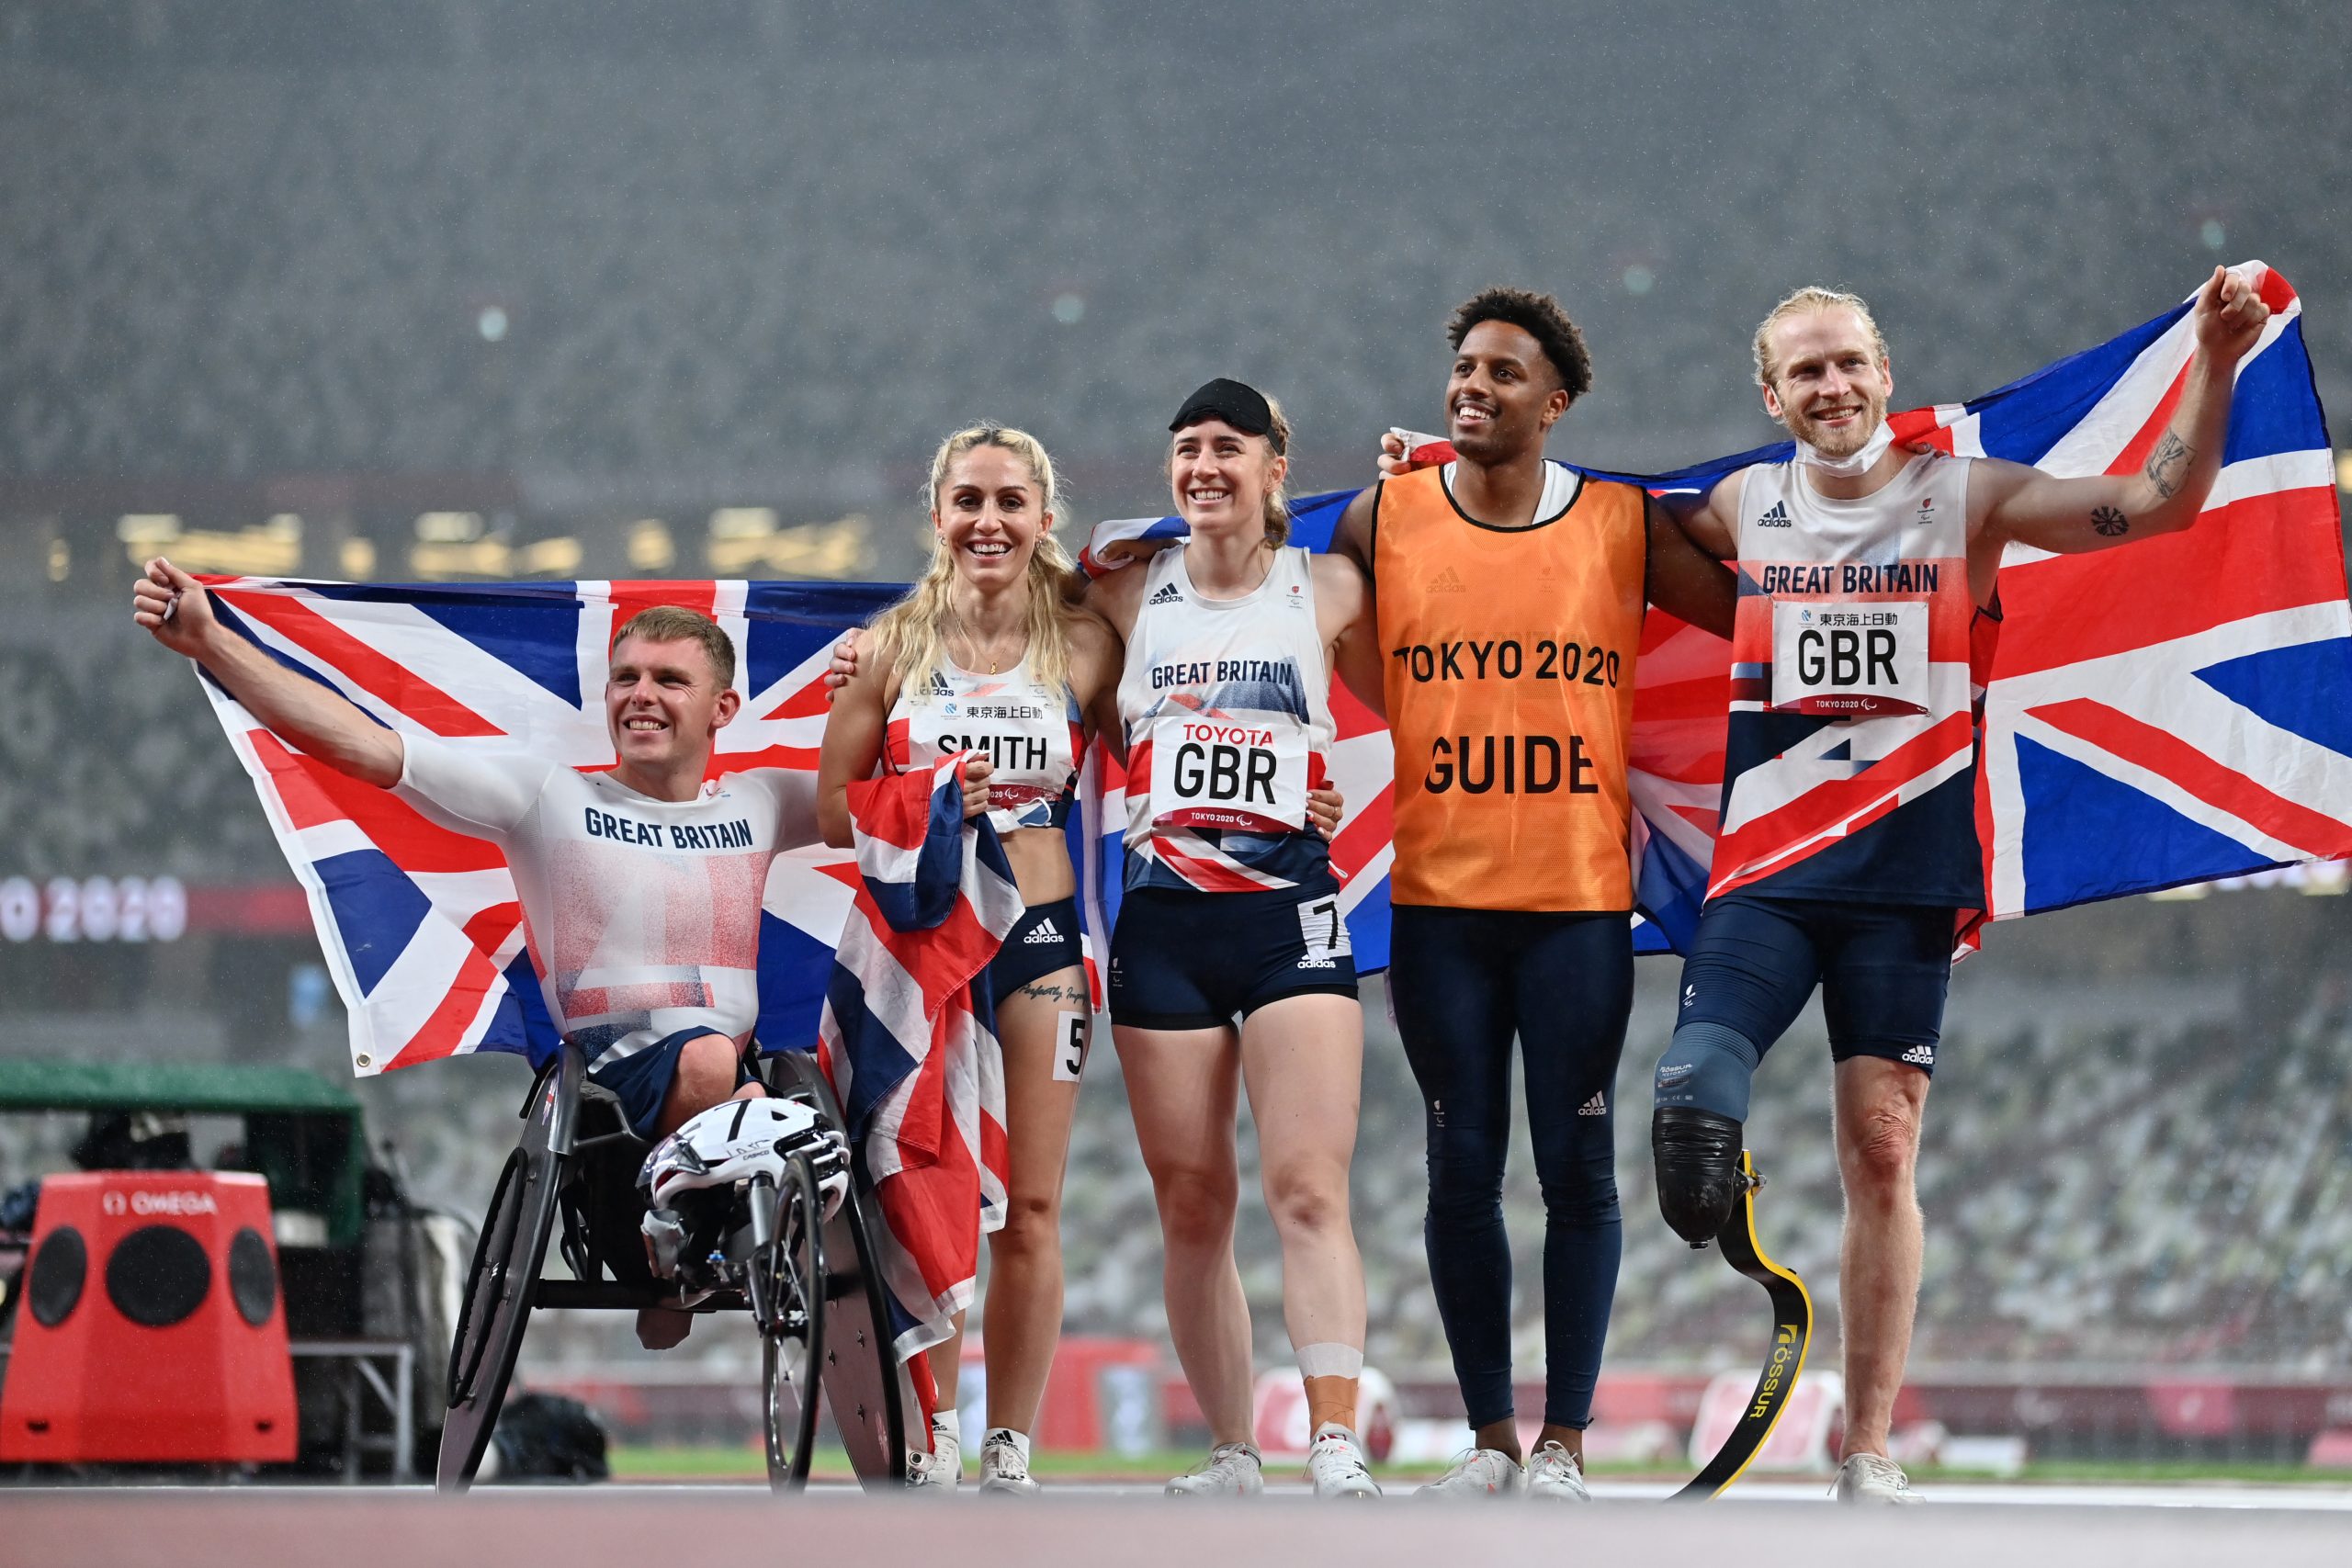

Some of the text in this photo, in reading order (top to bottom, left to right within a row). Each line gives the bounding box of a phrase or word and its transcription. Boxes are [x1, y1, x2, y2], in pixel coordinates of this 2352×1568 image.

[1758, 517, 1792, 527] adidas
[1425, 583, 1466, 593] adidas
[1763, 564, 1938, 593] GREAT BRITAIN
[1149, 594, 1183, 605] adidas
[1819, 613, 1898, 626] 東京海上日動
[1393, 640, 1620, 688] TOKYO 2020
[1798, 629, 1899, 685] GBR
[1152, 660, 1293, 689] GREAT BRITAIN
[967, 705, 1043, 719] 東京海上日動
[1815, 700, 1859, 709] TOKYO 2020
[1183, 724, 1274, 748] TOYOTA
[1174, 743, 1277, 805] GBR
[1424, 736, 1599, 794] GUIDE
[585, 807, 753, 849] GREAT BRITAIN
[1191, 812, 1235, 823] TOKYO 2020
[1312, 900, 1339, 950] 7
[1023, 933, 1064, 944] adidas
[1297, 957, 1336, 969] adidas
[1066, 1018, 1086, 1075] 5
[1902, 1053, 1934, 1065] adidas
[1577, 1106, 1607, 1116] adidas
[130, 1191, 218, 1215] OMEGA
[1749, 1347, 1792, 1418] ÖSSUR
